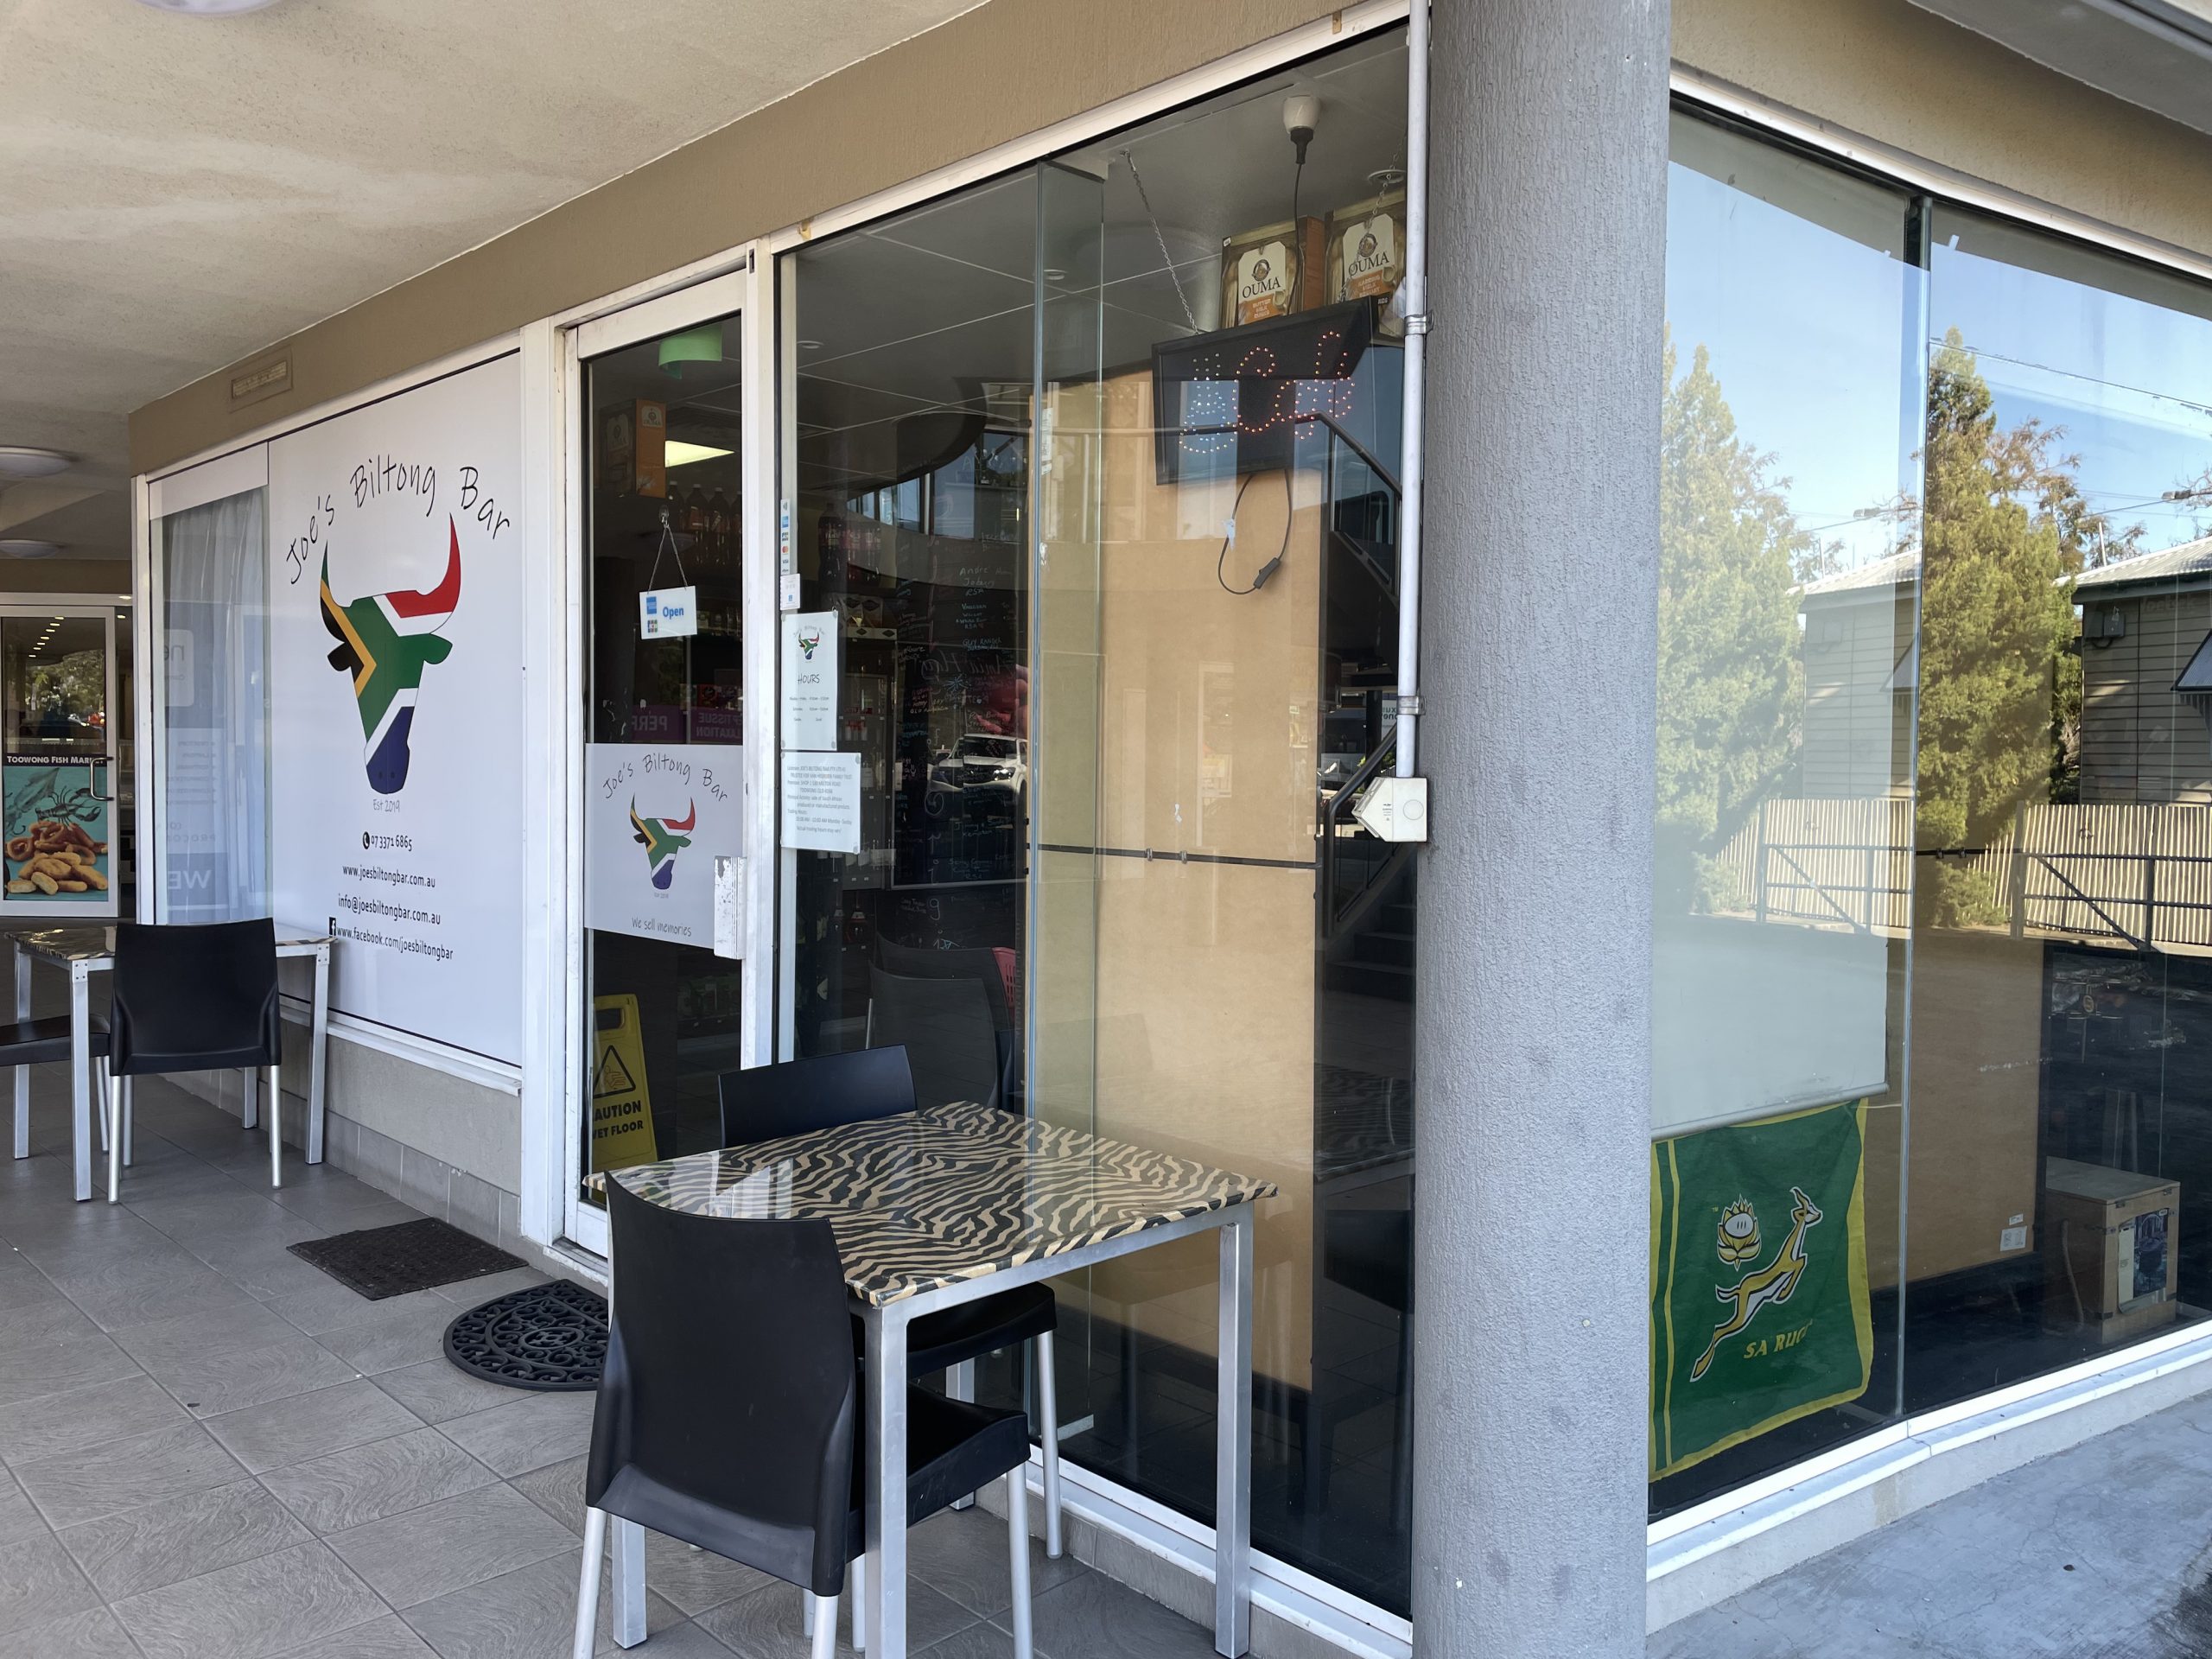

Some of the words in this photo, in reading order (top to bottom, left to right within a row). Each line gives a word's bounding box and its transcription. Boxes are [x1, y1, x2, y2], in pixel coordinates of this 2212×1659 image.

[1348, 251, 1389, 276] OUMA
[1242, 276, 1281, 299] OUMA
[286, 493, 334, 584] Joe's
[350, 454, 435, 517] Biltong
[460, 467, 510, 539] Bar
[662, 606, 684, 620] Open
[797, 673, 820, 685] HOURS
[602, 761, 633, 799] Joe's
[642, 753, 691, 785] Biltong
[702, 768, 728, 802] Bar
[372, 798, 384, 811] Est
[385, 799, 401, 813] 2019
[371, 835, 378, 847] 07
[378, 836, 394, 849] 3371
[395, 834, 412, 852] 6865
[342, 864, 436, 888] www.joesbiltongbar.com.au
[338, 893, 441, 925] info@joesbiltongbar.com.au
[631, 917, 642, 929] We
[644, 918, 656, 931] sell
[657, 921, 692, 938] memories
[336, 926, 454, 962] www.facebook.com/joesbiltongbar
[594, 1100, 642, 1122] AUTION
[611, 1120, 644, 1136] FLOOR
[1743, 1339, 1768, 1359] SA
